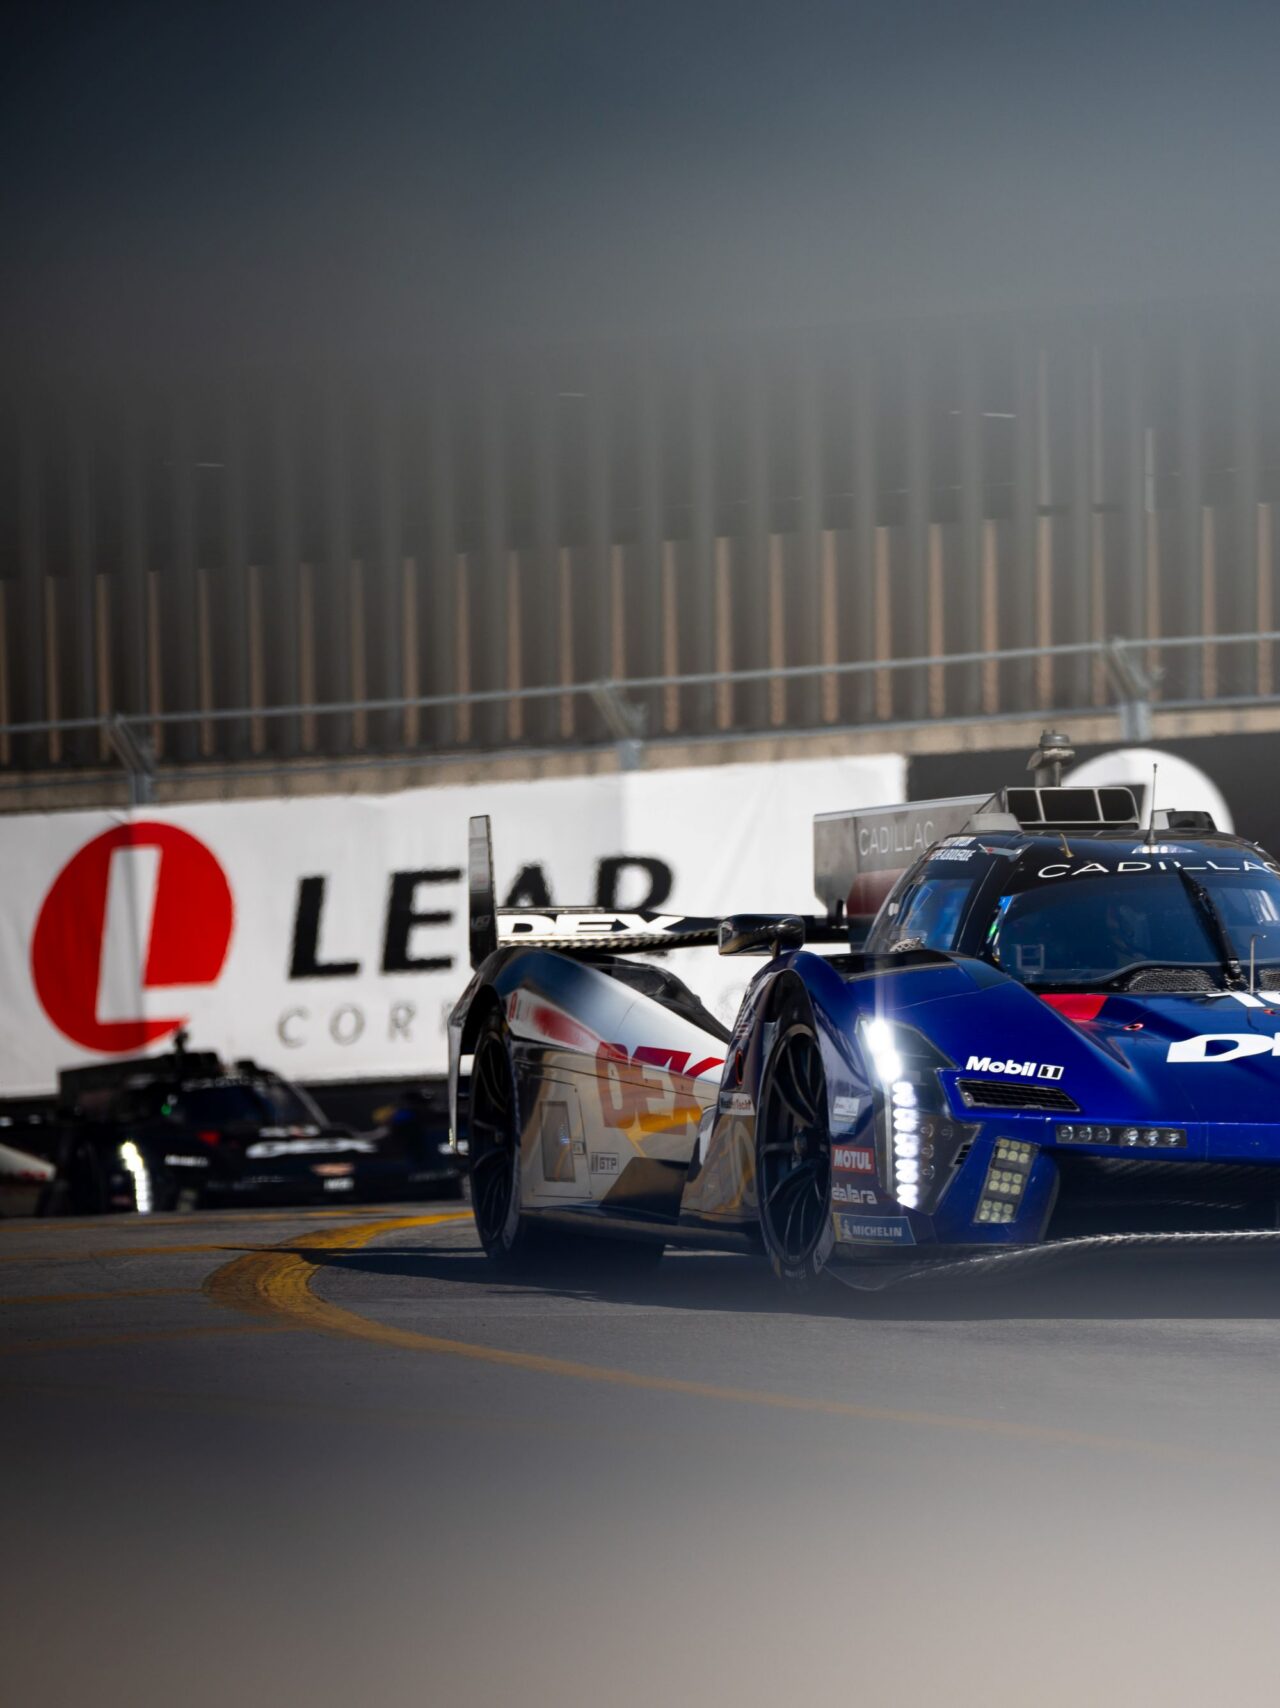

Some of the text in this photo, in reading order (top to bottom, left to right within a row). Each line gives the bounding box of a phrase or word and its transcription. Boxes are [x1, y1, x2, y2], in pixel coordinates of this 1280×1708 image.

[858, 820, 935, 857] CADILLAC
[965, 1055, 1065, 1080] Mobil 1
[834, 1151, 872, 1170] MOTUL
[852, 1224, 903, 1237] MICHELIN
